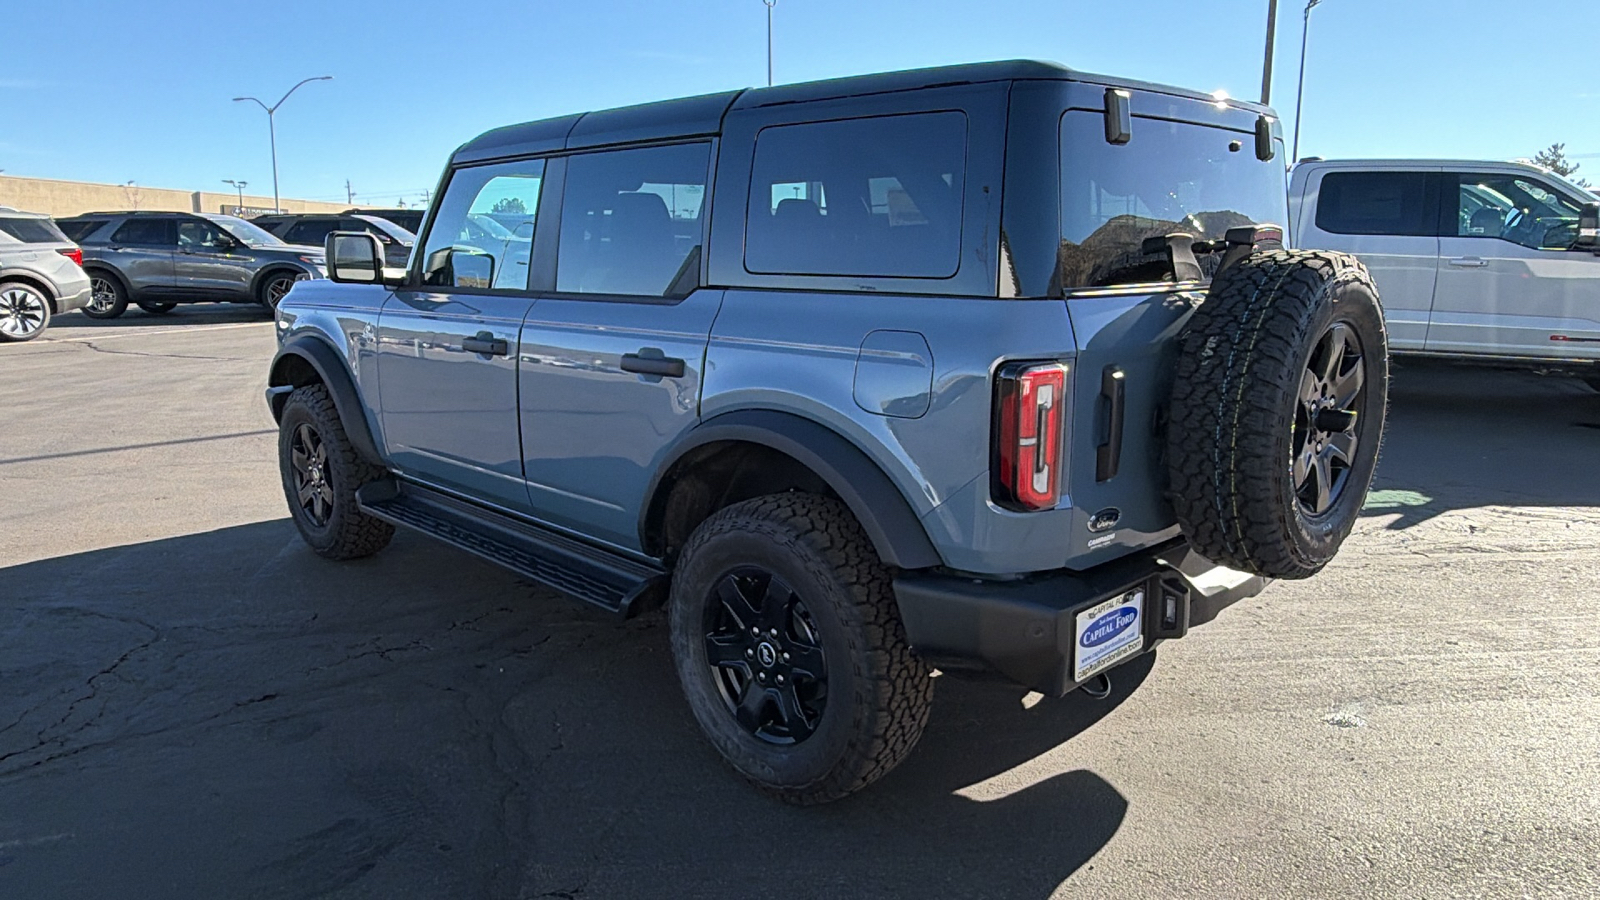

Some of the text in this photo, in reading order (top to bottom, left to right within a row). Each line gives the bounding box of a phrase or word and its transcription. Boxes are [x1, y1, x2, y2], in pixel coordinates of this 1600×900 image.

[1093, 600, 1115, 617] CAPITAL
[1083, 624, 1115, 645] CAPITAL
[1115, 612, 1135, 629] FORD
[1077, 640, 1142, 679] capitalfordonline.com
